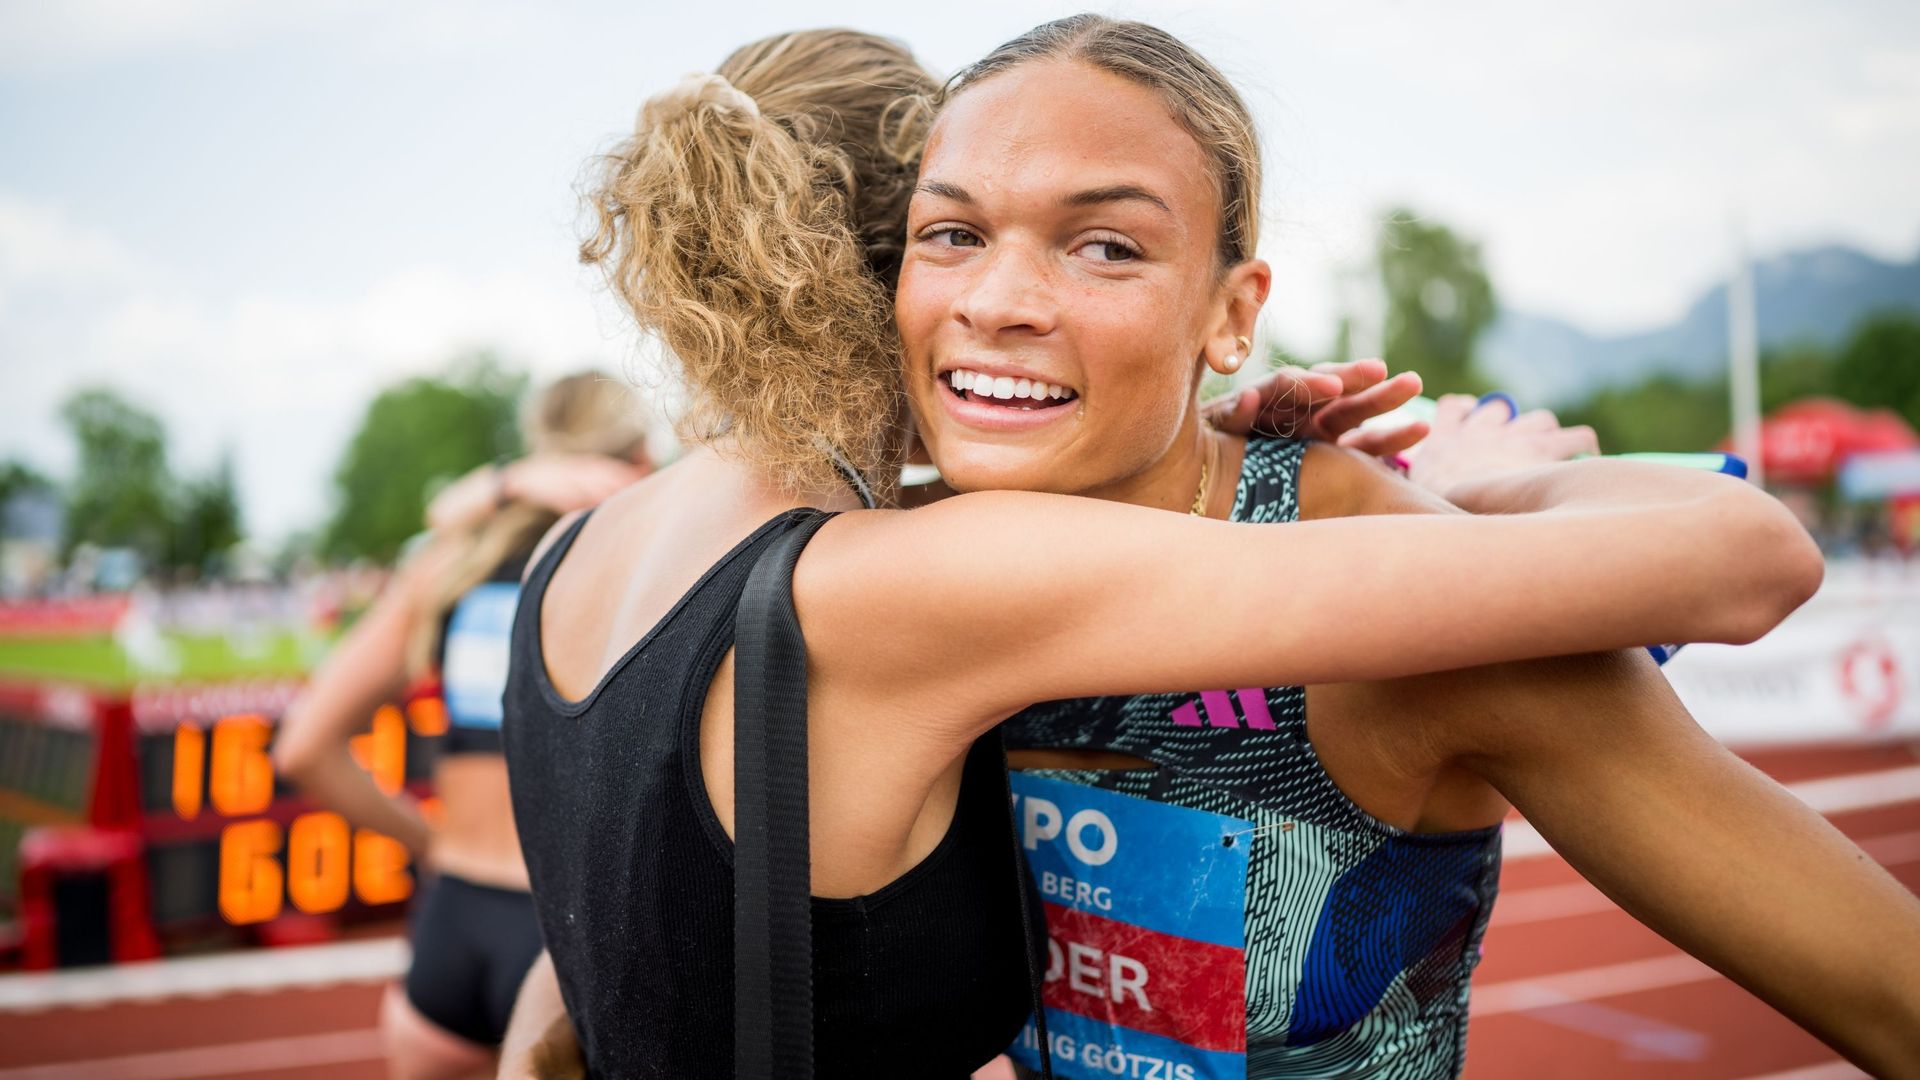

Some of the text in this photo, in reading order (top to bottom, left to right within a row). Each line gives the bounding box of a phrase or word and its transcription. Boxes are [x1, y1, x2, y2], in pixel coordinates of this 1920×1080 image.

[1012, 793, 1118, 866] PO
[1040, 870, 1112, 911] BERG
[1081, 1042, 1195, 1080] GÖTZIS
